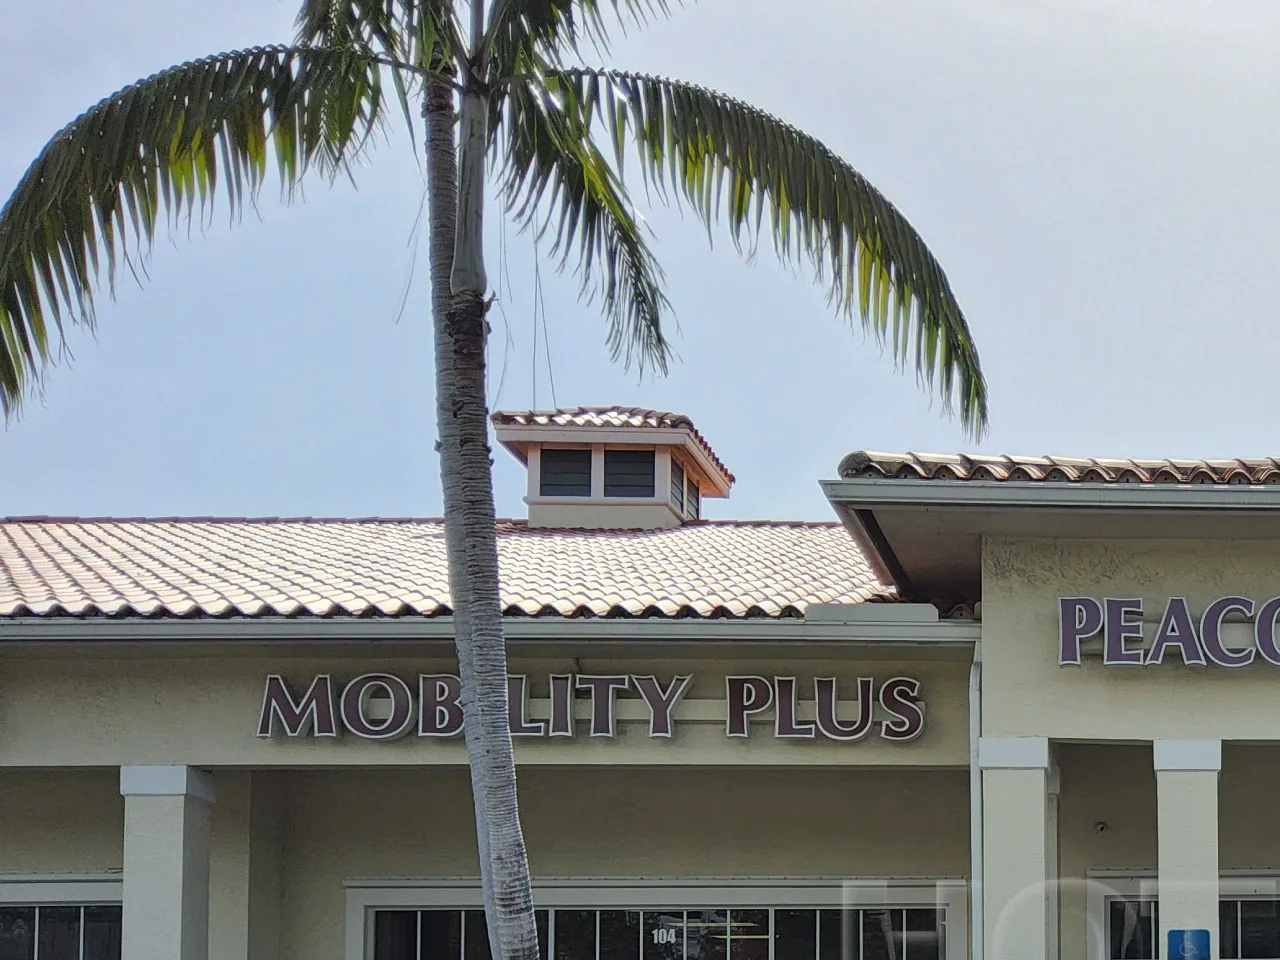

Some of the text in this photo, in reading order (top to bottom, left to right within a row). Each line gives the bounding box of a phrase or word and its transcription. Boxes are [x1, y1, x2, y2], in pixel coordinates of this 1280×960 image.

[256, 672, 925, 741] MOBLITY PLUS
[651, 928, 676, 944] 104
